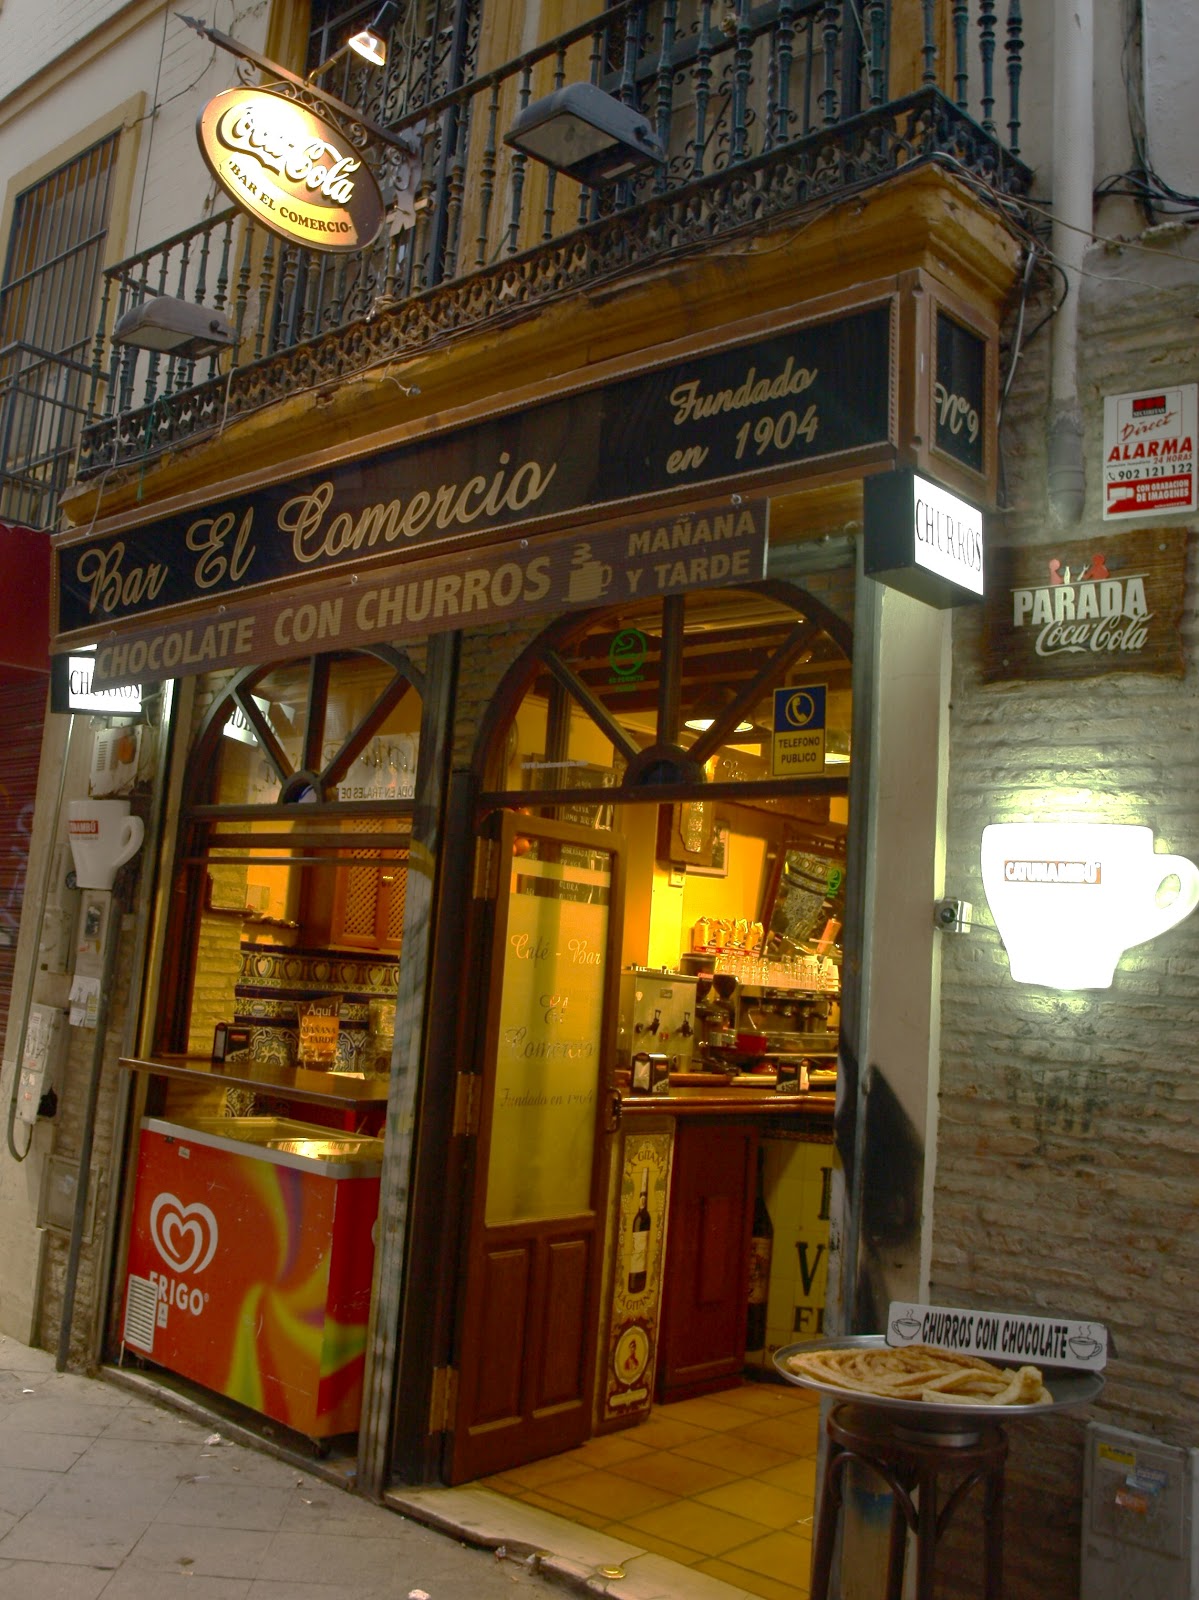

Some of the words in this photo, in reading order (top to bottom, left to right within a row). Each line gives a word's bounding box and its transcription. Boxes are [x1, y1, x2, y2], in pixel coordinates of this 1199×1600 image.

[231, 164, 257, 195] BAR
[260, 192, 276, 211] EL
[279, 206, 348, 233] COMERCIO
[669, 355, 819, 425] Fundado
[666, 445, 709, 475] en
[735, 405, 820, 461] 1904
[1108, 436, 1193, 462] ALARMA
[1121, 411, 1177, 441] Direct
[1118, 469, 1140, 481] 902
[1145, 466, 1165, 477] 121
[1171, 462, 1193, 474] 122
[1153, 455, 1164, 465] 24
[1166, 452, 1193, 463] HORAS
[1136, 493, 1147, 502] DE
[1148, 488, 1189, 501] IMAGENES
[76, 541, 169, 614] Bar
[186, 506, 256, 589] El
[277, 452, 557, 564] Comercio
[627, 510, 757, 558] MAÑANA
[915, 498, 982, 573] CHURROS
[626, 568, 644, 594] Y
[654, 549, 751, 590] TARDE
[99, 616, 257, 680] CHOCOLATE
[273, 597, 344, 647] CON
[356, 556, 553, 632] CHURROS
[1013, 577, 1149, 627] PARADA
[511, 934, 549, 968] Café
[568, 938, 602, 966] Bar
[921, 1311, 974, 1349] CHURROS
[975, 1318, 1000, 1351] CON
[1001, 1320, 1069, 1359] CHOCOLATE
